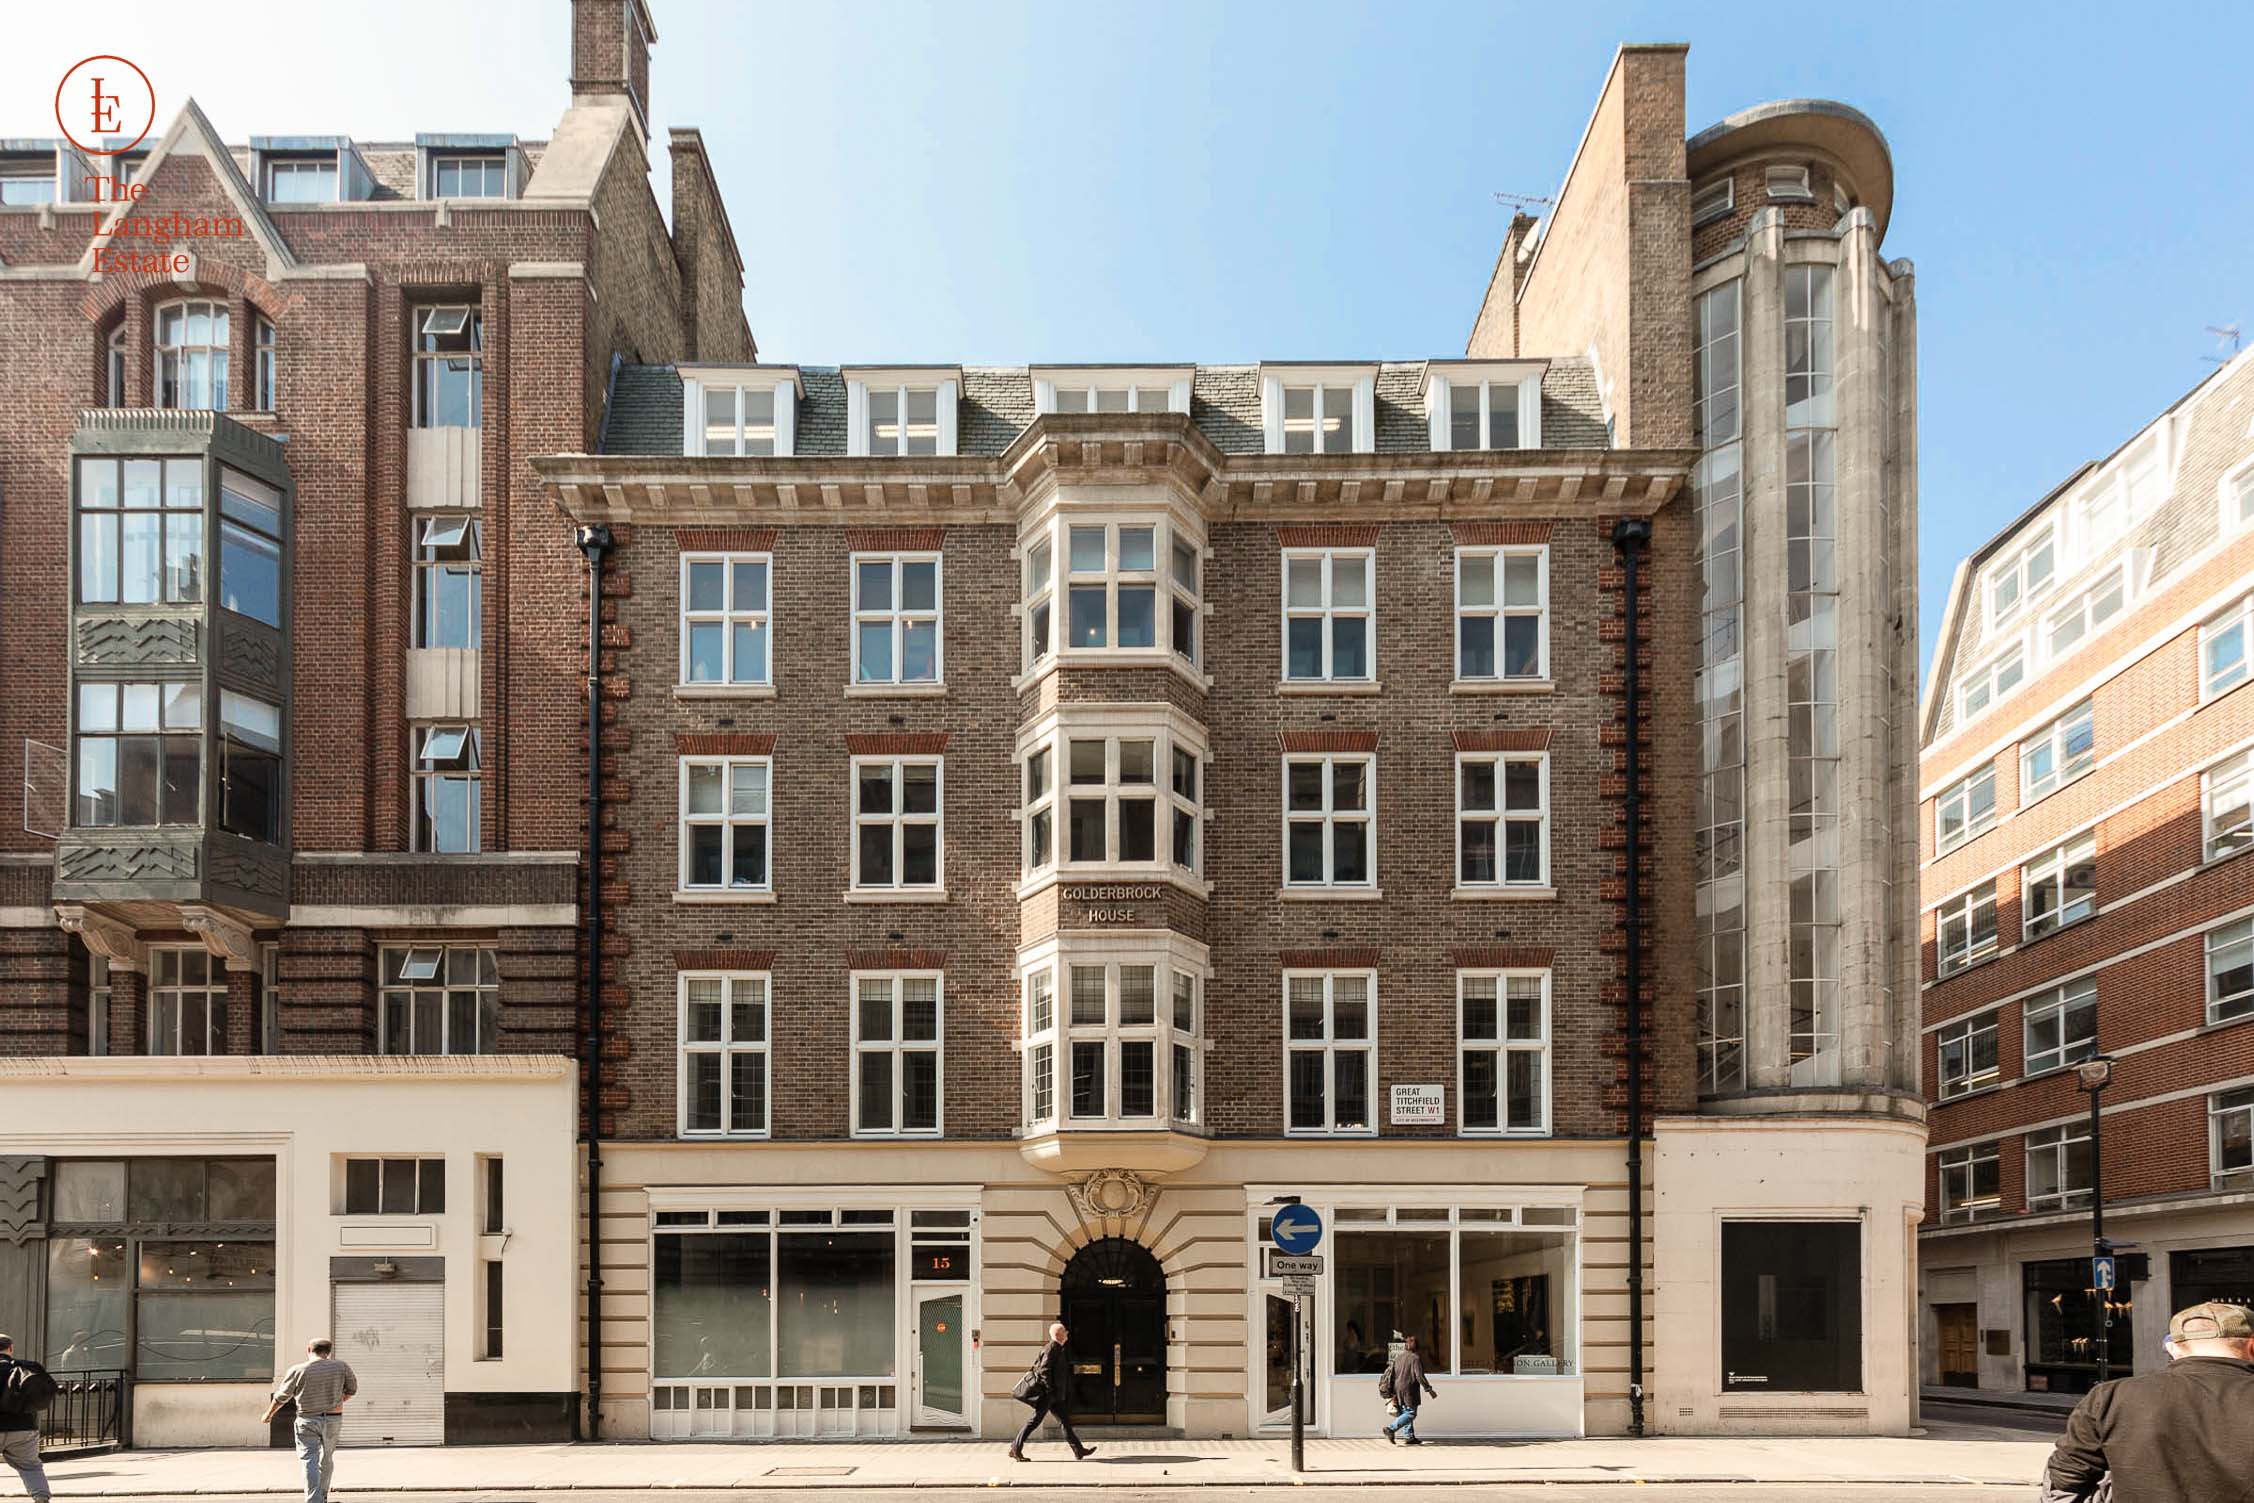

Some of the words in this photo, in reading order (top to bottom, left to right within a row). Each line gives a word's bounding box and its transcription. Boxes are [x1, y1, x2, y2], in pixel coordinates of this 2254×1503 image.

[1063, 887, 1161, 900] GOLDERBROCK
[1088, 909, 1135, 922] HOUSE
[1396, 1087, 1420, 1096] GREAT
[1396, 1097, 1440, 1105] TITCHFIELD
[1396, 1106, 1425, 1115] STREET
[933, 1257, 950, 1269] 15
[1277, 1260, 1296, 1269] One
[1299, 1262, 1318, 1271] way
